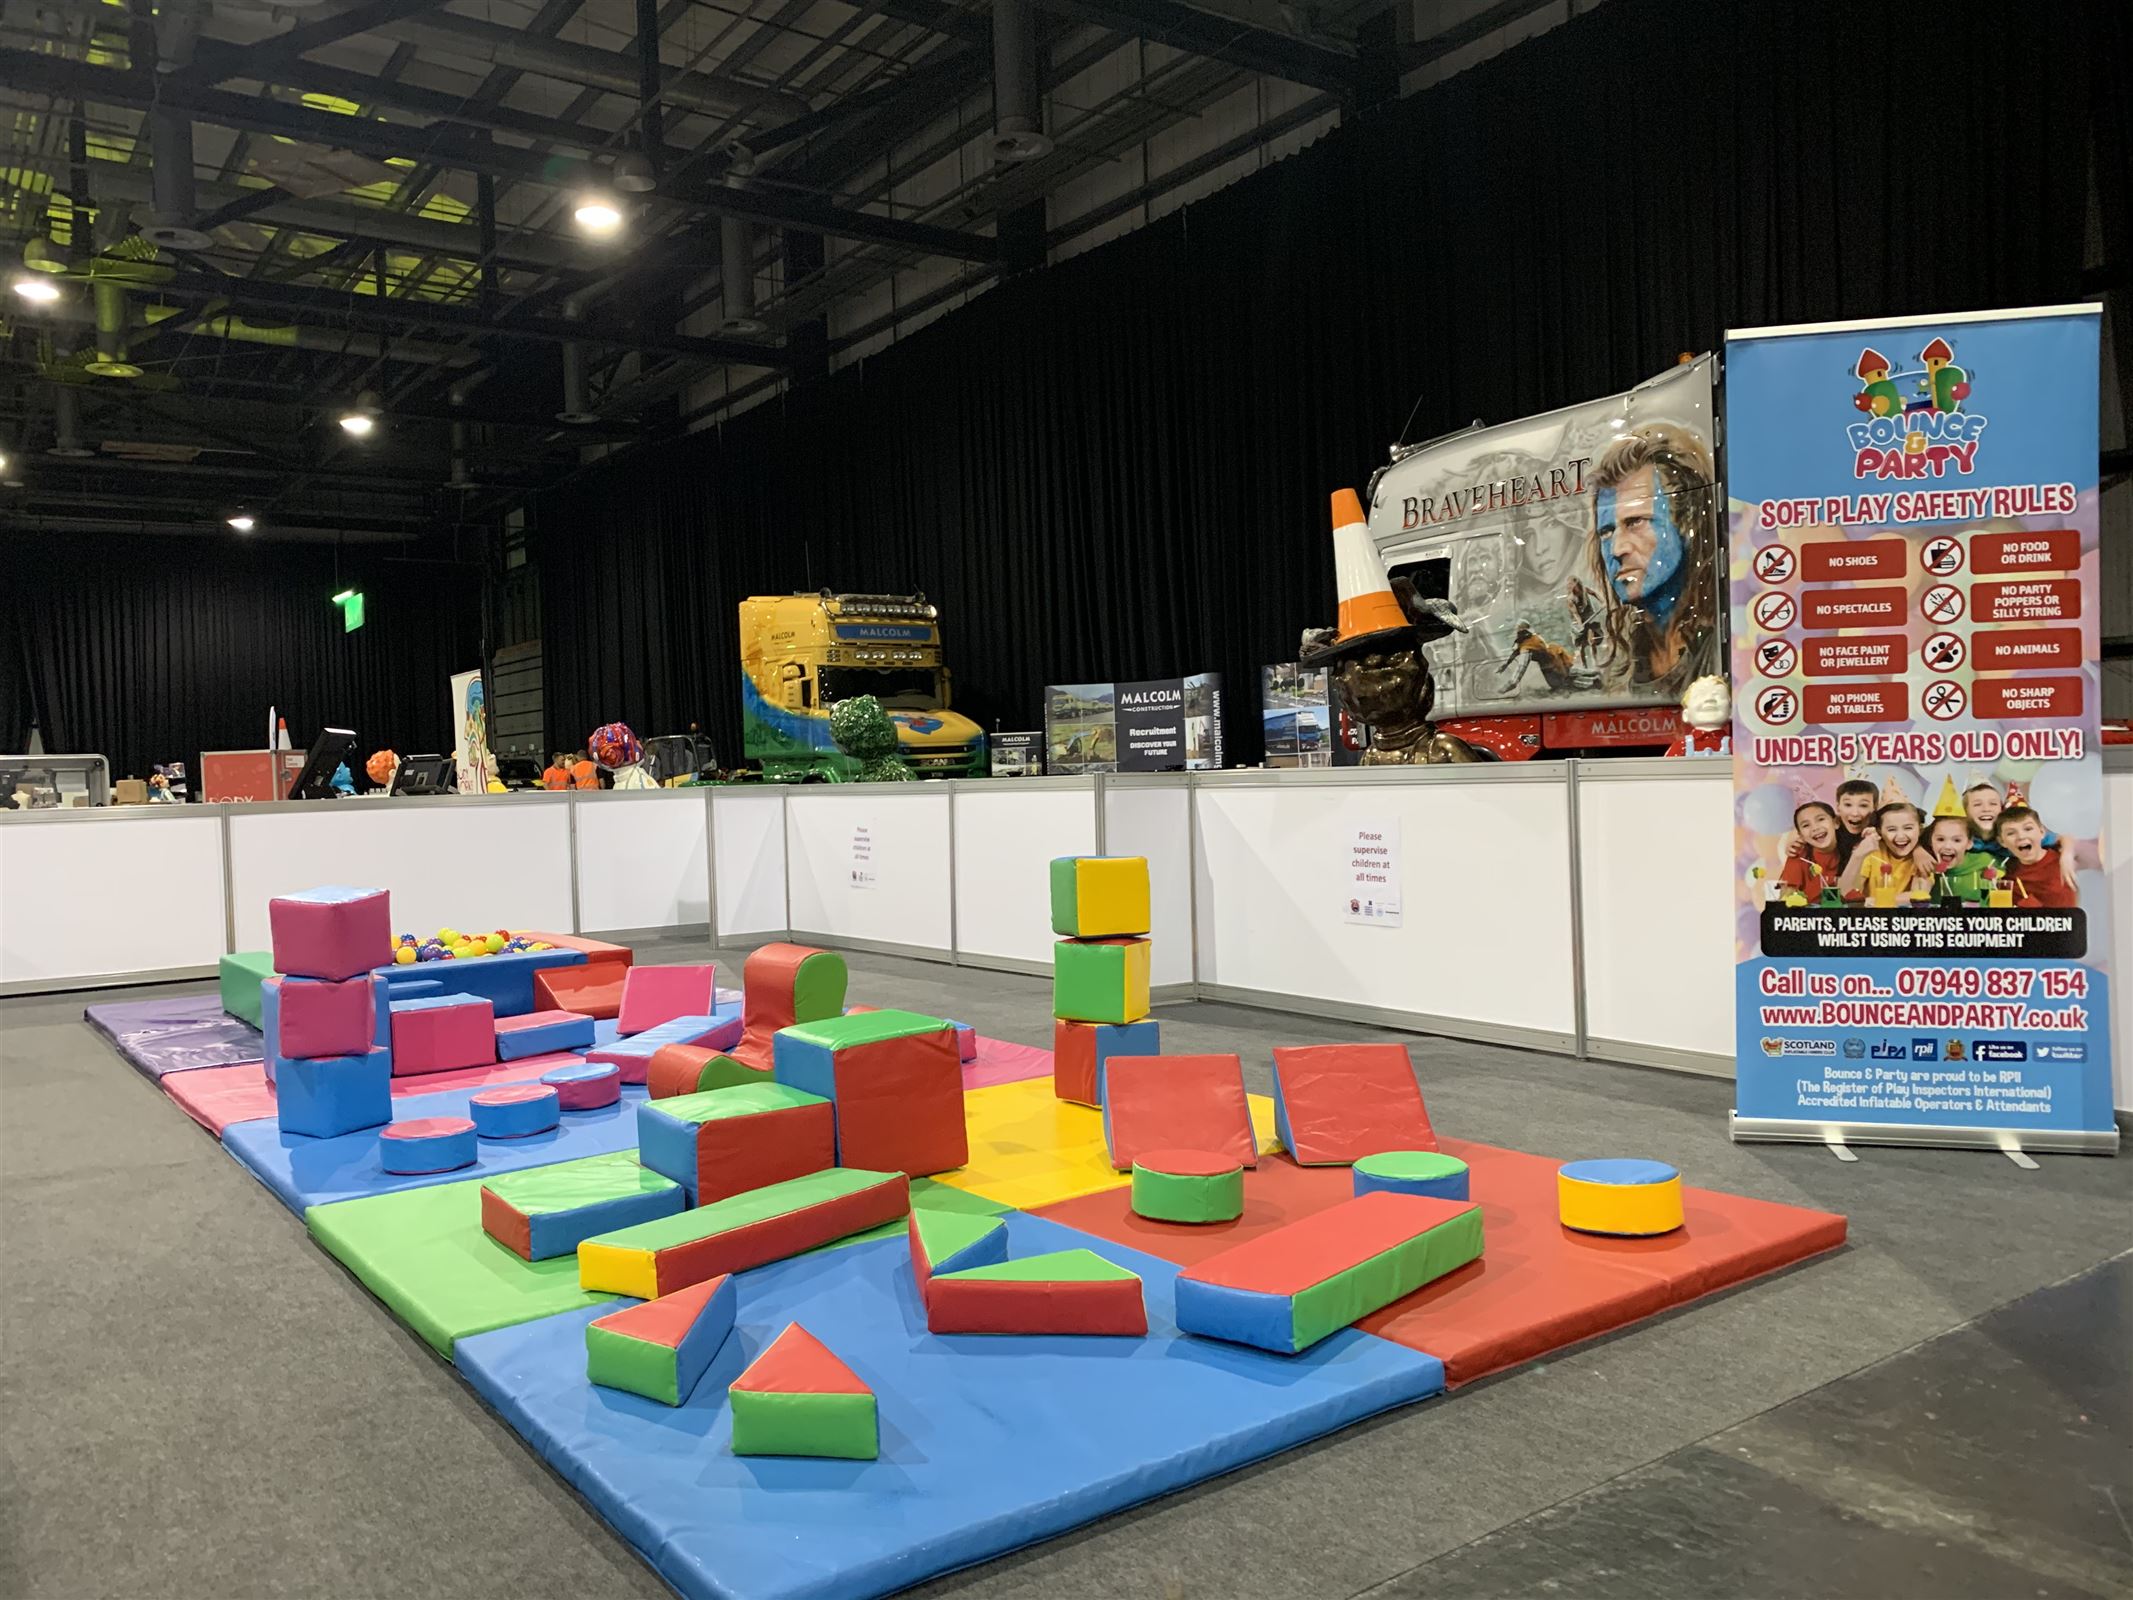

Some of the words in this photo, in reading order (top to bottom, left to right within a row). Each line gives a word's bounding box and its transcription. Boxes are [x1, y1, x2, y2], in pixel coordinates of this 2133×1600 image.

[1848, 413, 1986, 450] BOUNCE
[1905, 432, 1927, 455] &
[1856, 441, 1978, 479] PARTY
[1402, 457, 1591, 530] BRAVEHEART
[1761, 500, 1820, 528] SOFT
[1827, 495, 1889, 523] PLAY
[1895, 490, 1987, 520] SAFETY
[1991, 485, 2076, 516] RULES
[2003, 543, 2019, 553] NO
[2020, 541, 2049, 552] FOOD
[1829, 557, 1844, 567] NO
[1846, 555, 1878, 566] SHOES
[2001, 554, 2017, 564] OR
[2018, 553, 2052, 563] DRINK
[2001, 585, 2017, 595] NO
[2019, 584, 2052, 594] PARTY
[1994, 596, 2042, 607] POPPERS
[2044, 595, 2059, 605] OR
[1817, 605, 1832, 615] NO
[1833, 603, 1892, 614] SPECTACLES
[1993, 608, 2021, 619] SILLY
[2023, 606, 2061, 617] STRING
[859, 627, 911, 637] MALCOLM
[1819, 647, 1835, 657] NO
[1836, 646, 1859, 656] FACE
[1860, 645, 1890, 655] PAINT
[1995, 646, 2011, 656] NO
[2013, 644, 2060, 654] ANIMALS
[1820, 658, 1836, 668] OR
[1836, 656, 1889, 669] JEWELLERY
[1121, 690, 1181, 704] MALCOLM
[1830, 694, 1846, 704] NO
[1847, 693, 1881, 703] PHONE
[2002, 688, 2018, 698] NO
[2020, 687, 2055, 698] SHARP
[1827, 705, 1842, 715] OR
[1843, 703, 1884, 714] TABLETS
[2007, 699, 2050, 710] OBJECTS
[1129, 726, 1176, 736] Recruitment
[1592, 718, 1677, 734] MALCOLM
[1754, 736, 1834, 765] UNDER
[1840, 734, 1857, 762] 5
[1861, 733, 1943, 762] YEARS
[1950, 732, 1999, 760] OLD
[2006, 729, 2083, 759] ONLY!
[1359, 832, 1382, 841] Please
[1353, 847, 1388, 855] supervise
[1352, 859, 1381, 868] children
[1382, 861, 1390, 869] at
[1356, 873, 1365, 881] all
[1366, 874, 1387, 882] times
[1774, 917, 1836, 932] PARENTS,
[1839, 917, 1889, 931] PLEASE
[1892, 917, 1964, 931] SUPERVISE
[1966, 917, 2002, 931] YOUR
[2005, 917, 2072, 932] CHILDREN
[1818, 933, 1868, 947] WHILST
[1871, 933, 1911, 947] USING
[1914, 933, 1944, 947] THIS
[1947, 933, 2024, 948] EQUIPMENT
[1761, 969, 1803, 995] Call
[1810, 974, 1836, 995] us
[1844, 975, 1892, 996] on...
[1897, 969, 1980, 996] 07949
[1986, 970, 2034, 997] 837
[2041, 970, 2087, 997] 154
[1763, 1003, 2087, 1029] www.BOUNCEANDPARTY.co.uk
[1784, 1041, 1835, 1050] SCOTLAND
[1824, 1067, 1862, 1079] Bounce
[1875, 1068, 1908, 1083] Party
[1911, 1071, 1930, 1081] are
[1932, 1070, 1966, 1084] proud
[1968, 1071, 1980, 1082] to
[1983, 1071, 1997, 1082] be
[1797, 1079, 1820, 1094] (The
[1823, 1081, 1869, 1096] Register
[1871, 1082, 1884, 1094] of
[1886, 1083, 1910, 1097] Play
[1912, 1083, 1971, 1098] Inspectors
[1973, 1085, 2052, 1100] International)
[1798, 1094, 1857, 1108] Accredited
[1860, 1097, 1912, 1109] Inflatable
[1914, 1097, 1973, 1112] Operators
[1986, 1100, 2052, 1113] Attendants
